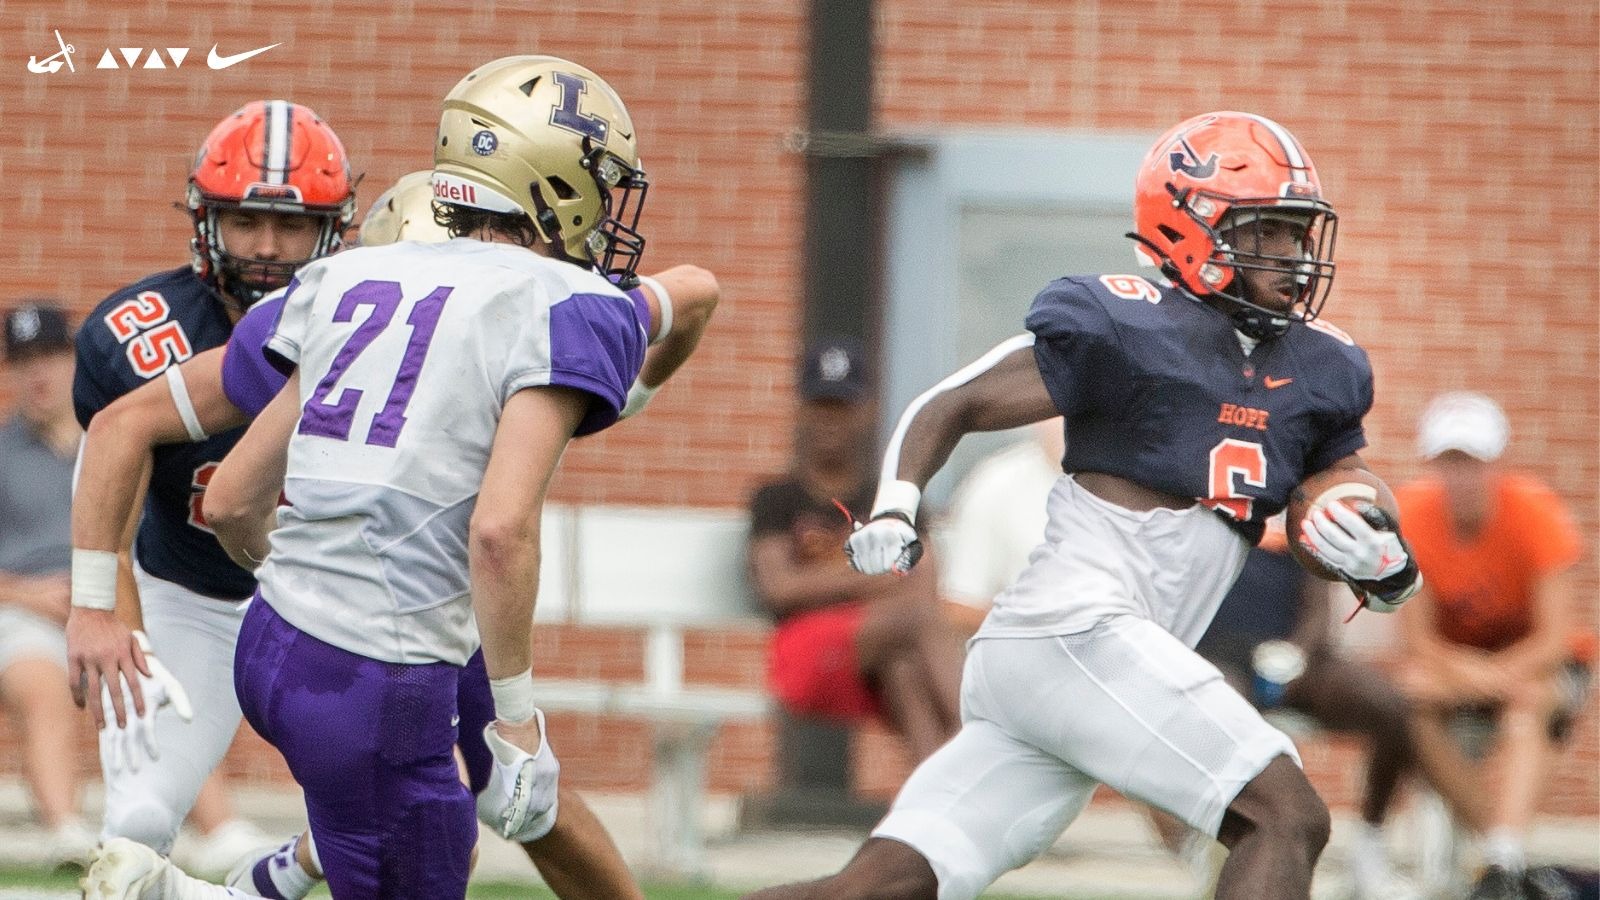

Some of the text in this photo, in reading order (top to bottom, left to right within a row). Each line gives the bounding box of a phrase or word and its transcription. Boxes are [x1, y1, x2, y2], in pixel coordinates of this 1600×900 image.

[478, 135, 493, 150] DC
[548, 71, 610, 146] L
[104, 290, 193, 379] 25
[298, 279, 455, 448] 21
[1217, 402, 1270, 431] HOPE
